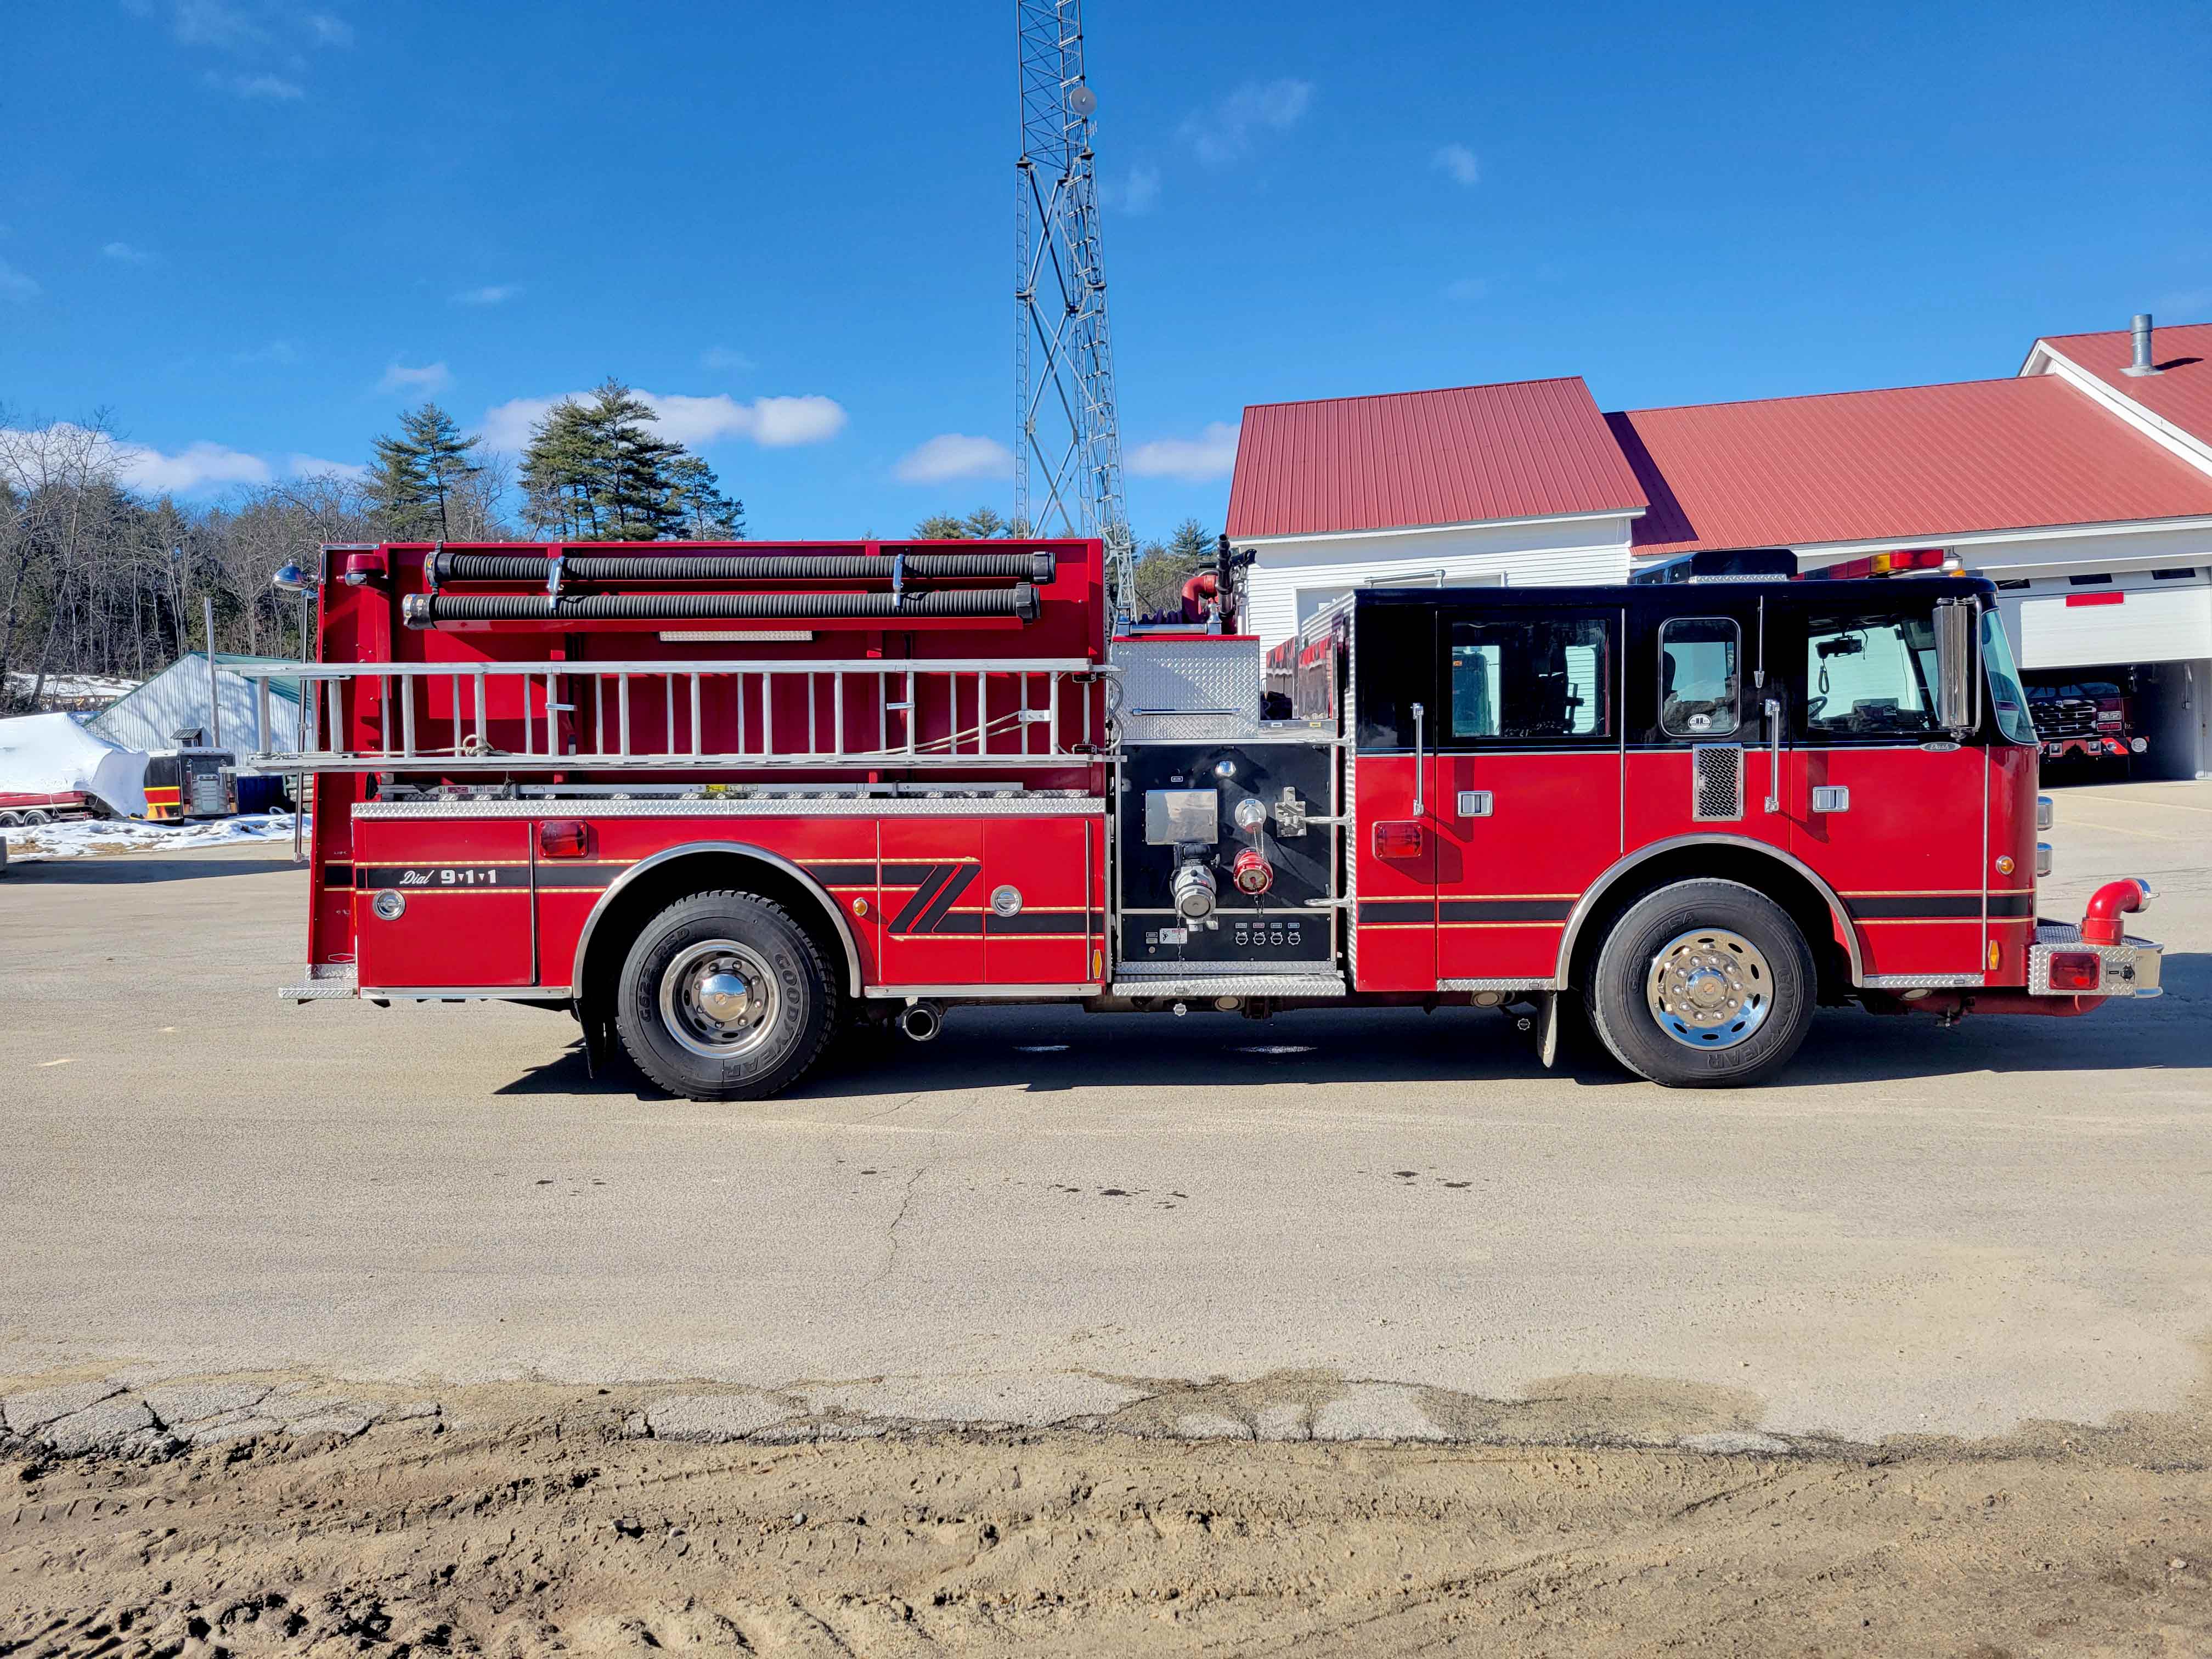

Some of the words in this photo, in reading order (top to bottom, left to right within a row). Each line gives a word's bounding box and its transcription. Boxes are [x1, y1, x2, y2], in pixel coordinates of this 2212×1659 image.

[399, 870, 435, 884] Dial
[639, 967, 656, 1022] G622
[653, 927, 690, 957] RSD
[724, 953, 800, 1077] GOODYEAR
[1707, 968, 1795, 1068] GOODYEAR
